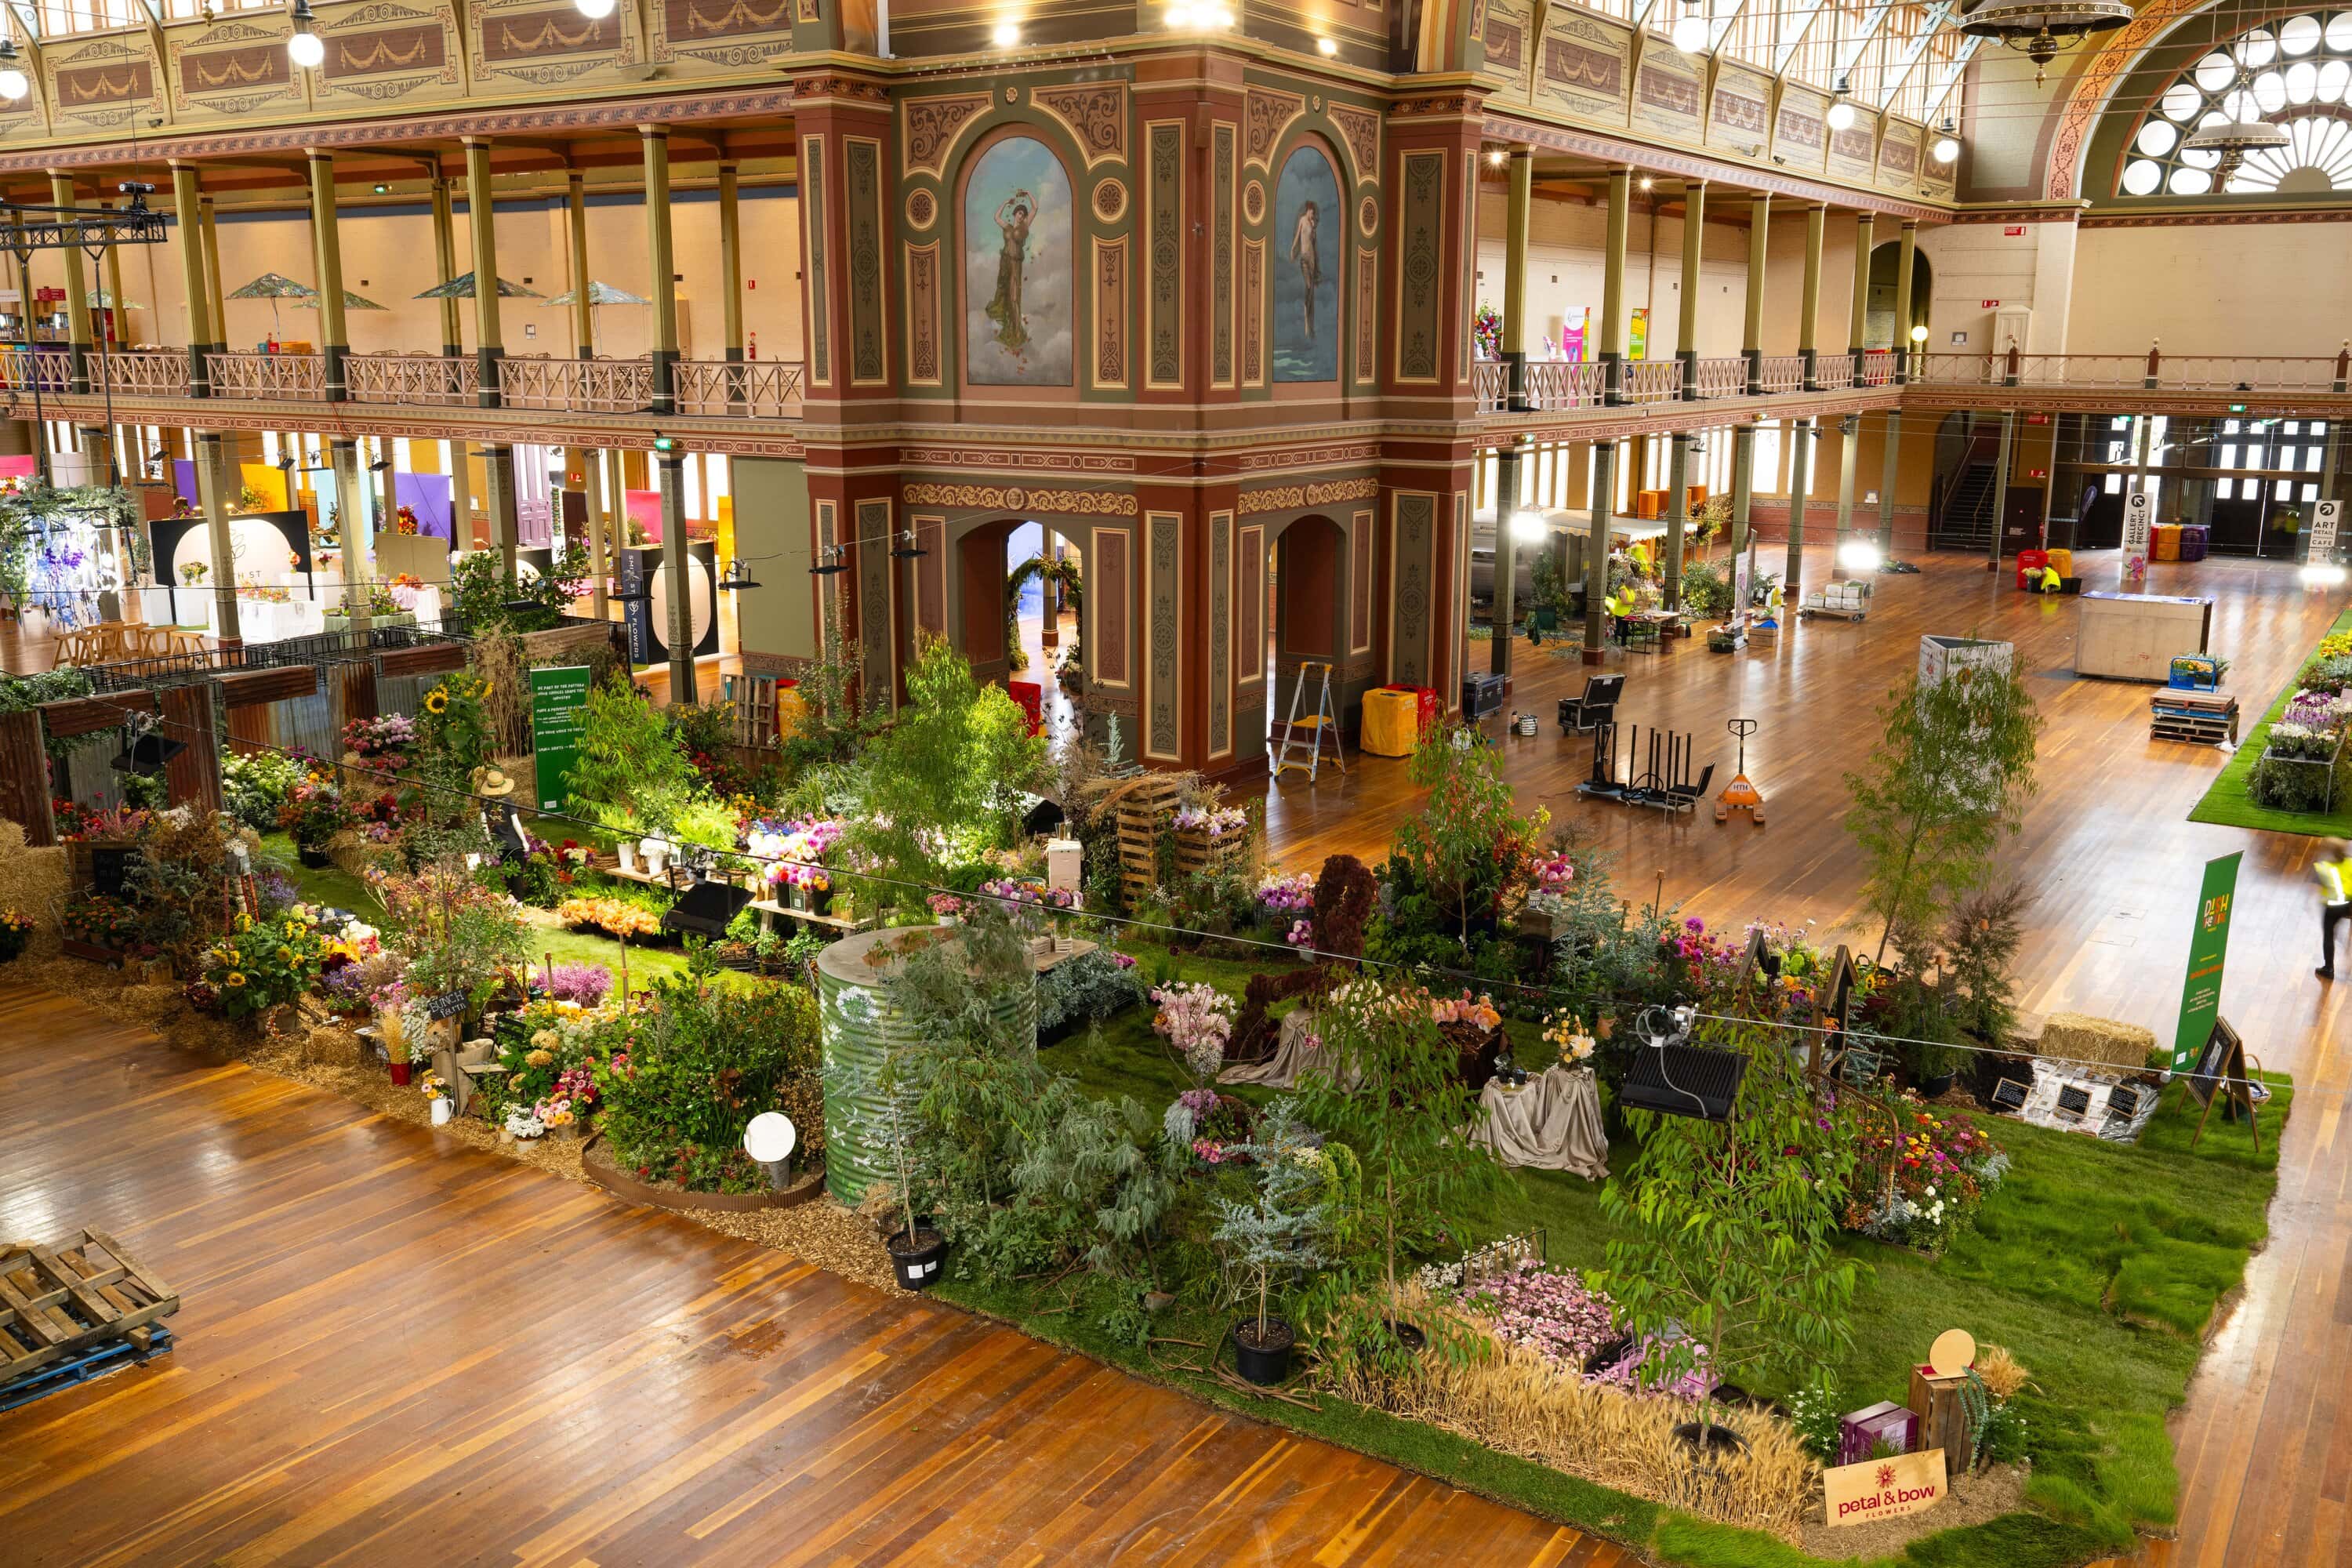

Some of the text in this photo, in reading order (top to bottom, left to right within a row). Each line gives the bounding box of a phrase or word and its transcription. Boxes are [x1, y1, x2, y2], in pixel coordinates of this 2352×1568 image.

[2136, 510, 2145, 544] PRECINCT
[2204, 893, 2230, 917] DISH
[429, 990, 465, 1013] BUNCH
[1838, 1486, 1935, 1519] petal & bow
[1865, 1505, 1912, 1519] FLOWERS
